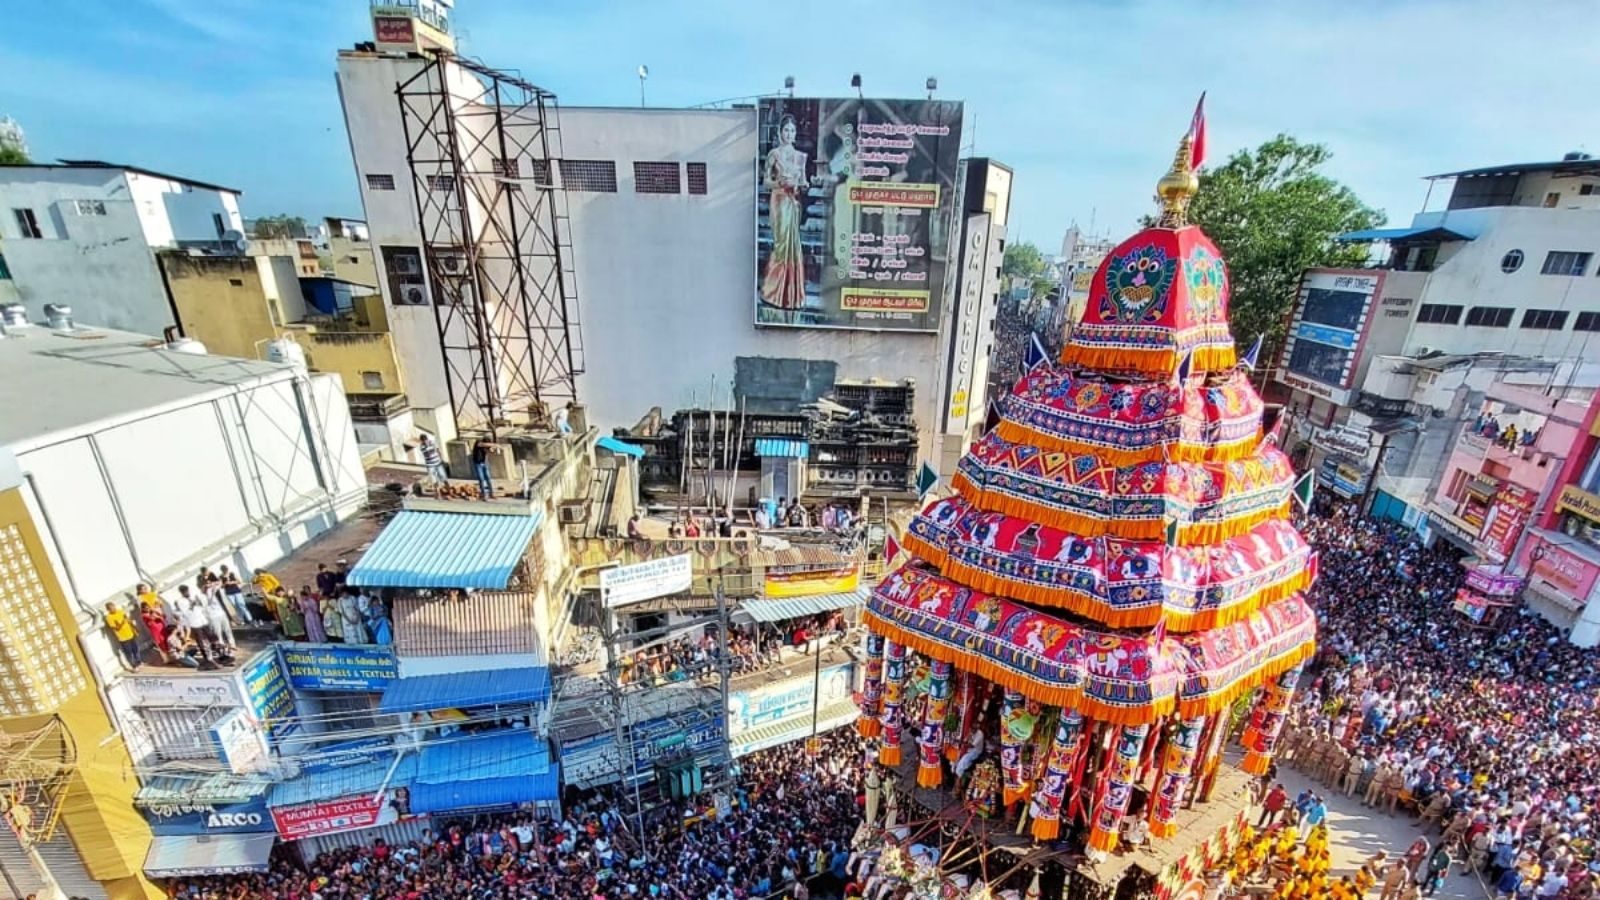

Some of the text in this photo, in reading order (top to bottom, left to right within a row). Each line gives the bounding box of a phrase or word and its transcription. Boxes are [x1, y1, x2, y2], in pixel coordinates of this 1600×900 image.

[291, 666, 321, 677] JAYAM
[361, 670, 396, 679] TEXTILES
[207, 812, 262, 828] ARCO
